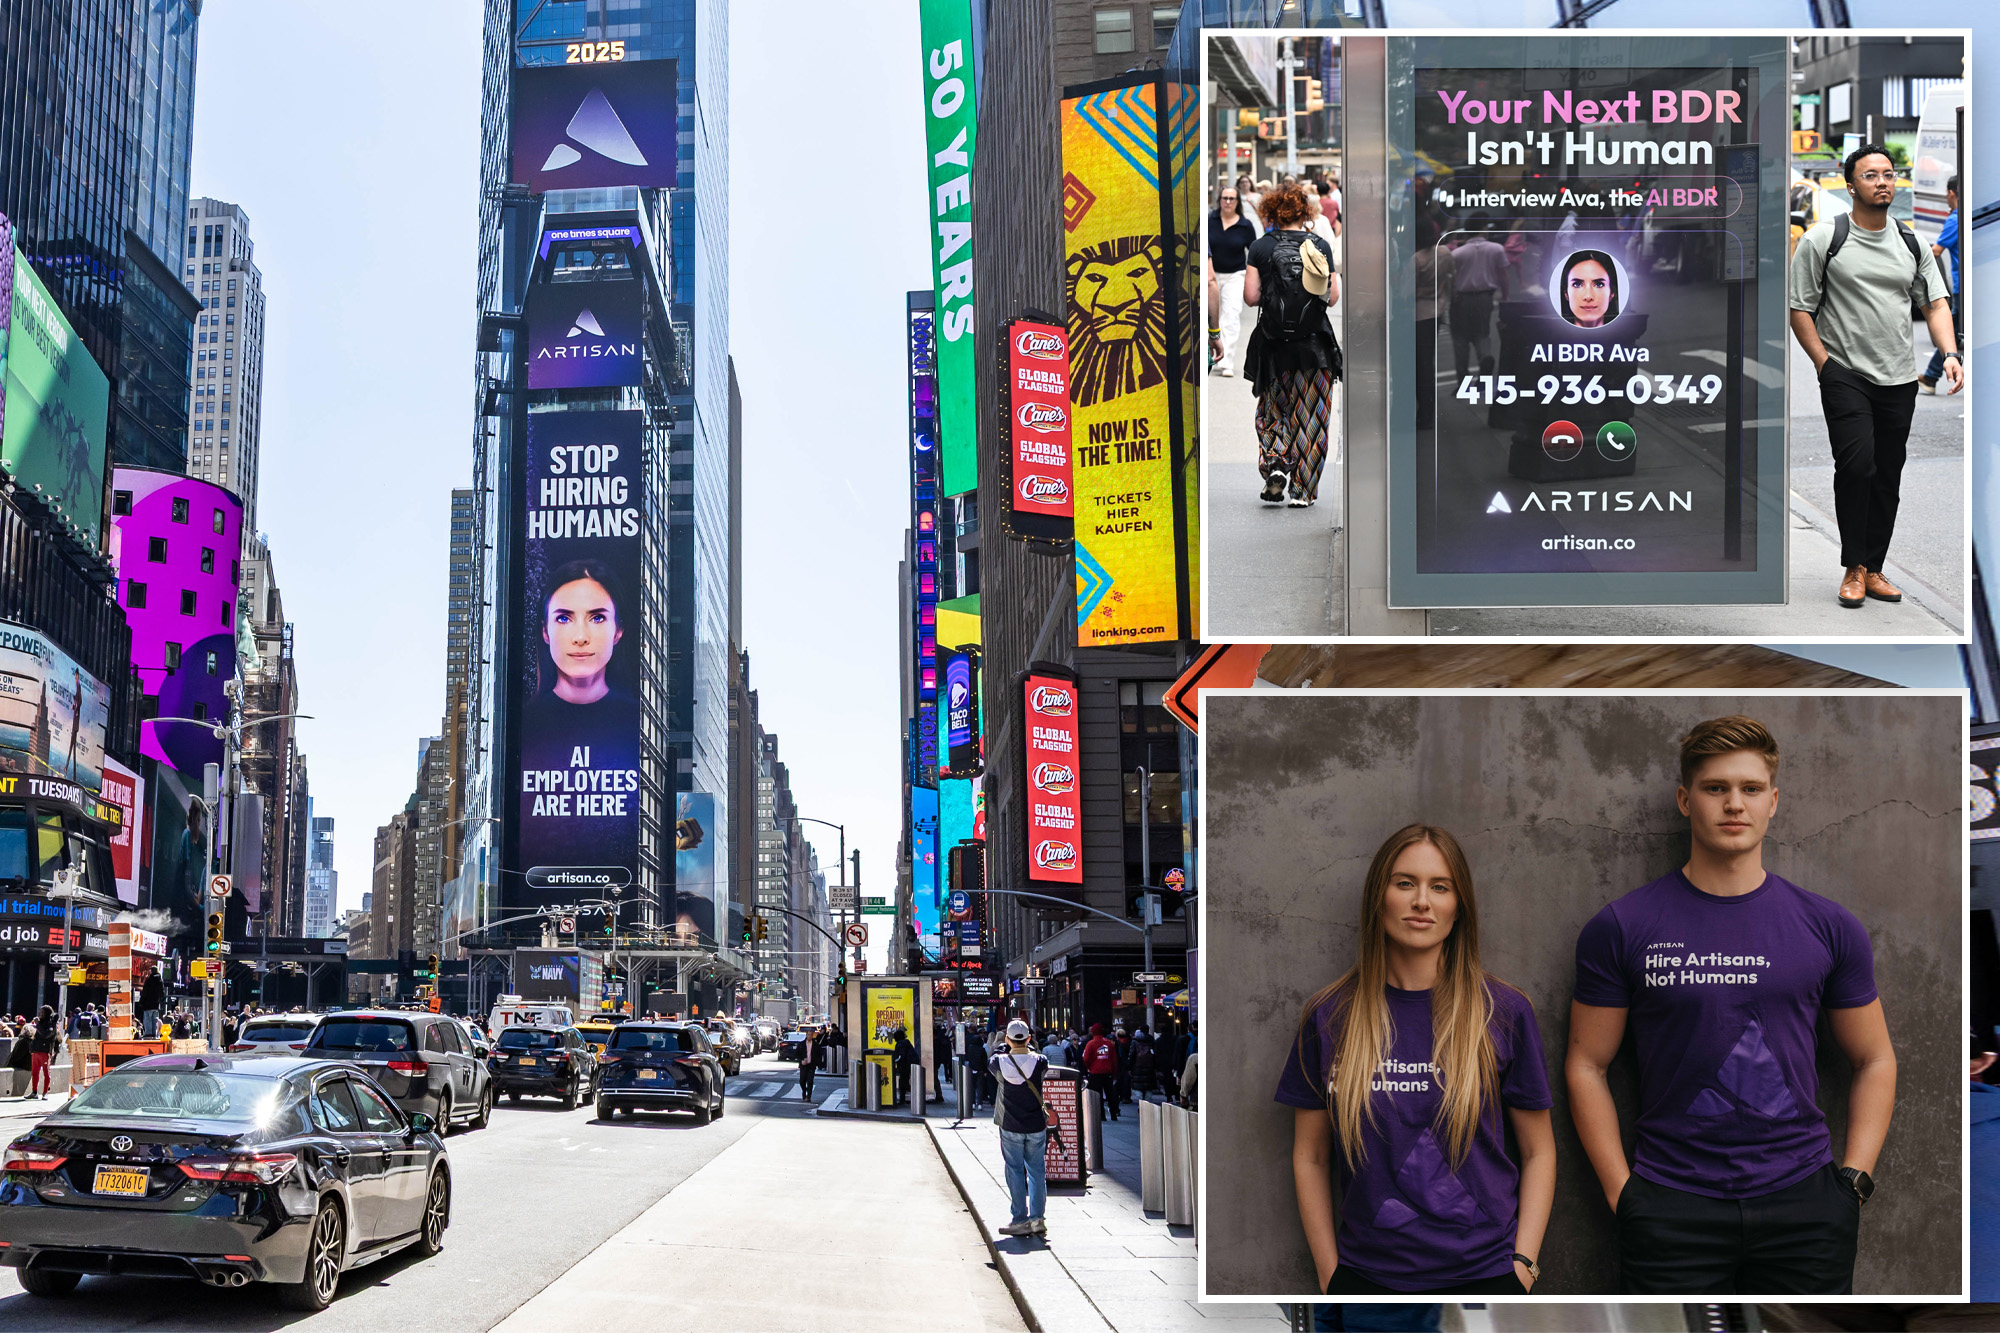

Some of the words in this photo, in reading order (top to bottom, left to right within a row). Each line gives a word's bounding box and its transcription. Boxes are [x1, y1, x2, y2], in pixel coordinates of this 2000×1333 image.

[566, 41, 625, 64] 2025
[930, 39, 964, 118] 50
[1437, 90, 1531, 125] Your
[1543, 90, 1641, 124] Next
[1652, 89, 1742, 124] BDR
[1467, 130, 1555, 165] Isn't
[1565, 131, 1713, 165] Human
[1460, 188, 1559, 207] Interview
[1559, 188, 1606, 210] Ava,
[1609, 187, 1643, 207] the
[1646, 188, 1668, 207] AI
[1672, 188, 1718, 207] BDR
[551, 230, 569, 240] one
[570, 228, 596, 239] times
[597, 227, 630, 239] square
[935, 126, 974, 342] YEARS
[16, 261, 32, 305] YOUR
[32, 284, 47, 324] NEXT
[46, 305, 68, 355] VERSION
[14, 292, 20, 320] IS
[21, 300, 36, 341] YOUR
[36, 324, 50, 359] BEST
[537, 344, 635, 359] ARTISAN
[1018, 331, 1062, 356] Cane's
[1530, 344, 1553, 362] AI
[1558, 344, 1604, 362] BDR
[1608, 344, 1650, 362] Ava
[1018, 368, 1064, 385] GLOBAL
[1018, 380, 1065, 394] FLAGSHIP
[1456, 374, 1723, 405] 415-936-0349
[1020, 402, 1065, 427] Cane's
[1088, 420, 1128, 445] NOW
[1132, 417, 1149, 439] IS
[1020, 440, 1066, 457] GLOBAL
[1078, 443, 1115, 468] THE
[1115, 438, 1161, 465] TIME!
[550, 444, 619, 474] STOP
[1020, 452, 1066, 466] FLAGSHIP
[540, 476, 628, 507] HIRING
[1022, 475, 1067, 500] Cane's
[1094, 492, 1152, 507] TICKETS
[1520, 491, 1692, 511] ARTISAN
[1107, 506, 1139, 519] HIER
[528, 508, 639, 539] HUMANS
[1095, 520, 1152, 536] KAUFEN
[1541, 534, 1635, 550] artisan.co
[1092, 625, 1165, 639] lionking.com
[1032, 686, 1071, 712] Cane's
[950, 709, 968, 721] TACO
[951, 719, 968, 731] BELL
[1032, 726, 1072, 743] GLOBAL
[1032, 739, 1073, 753] FLAGSHIP
[570, 746, 590, 768] AI
[522, 769, 638, 792] EMPLOYEES
[1034, 762, 1074, 789] Cane's
[97, 803, 109, 821] WILL
[532, 794, 571, 817] ARE
[576, 794, 627, 816] HERE
[1034, 803, 1074, 819] GLOBAL
[1034, 816, 1075, 829] FLAGSHIP
[1036, 840, 1076, 867] Cane's
[547, 872, 610, 884] artisan.co
[12, 900, 41, 915] trial
[75, 907, 82, 920] to
[83, 908, 95, 922] NYC
[15, 926, 40, 944] job
[1647, 942, 1685, 950] ARTISAN
[967, 961, 982, 970] Rock
[1645, 953, 1682, 970] Hire
[1685, 953, 1771, 968] Artisans,
[542, 968, 564, 980] NAVY
[1645, 973, 1676, 988] Not
[1681, 970, 1758, 985] Humans
[876, 1009, 905, 1020] OPERATION
[1372, 1059, 1441, 1075] rtisans,
[1371, 1078, 1429, 1092] umans
[100, 1173, 144, 1190] T732061C
